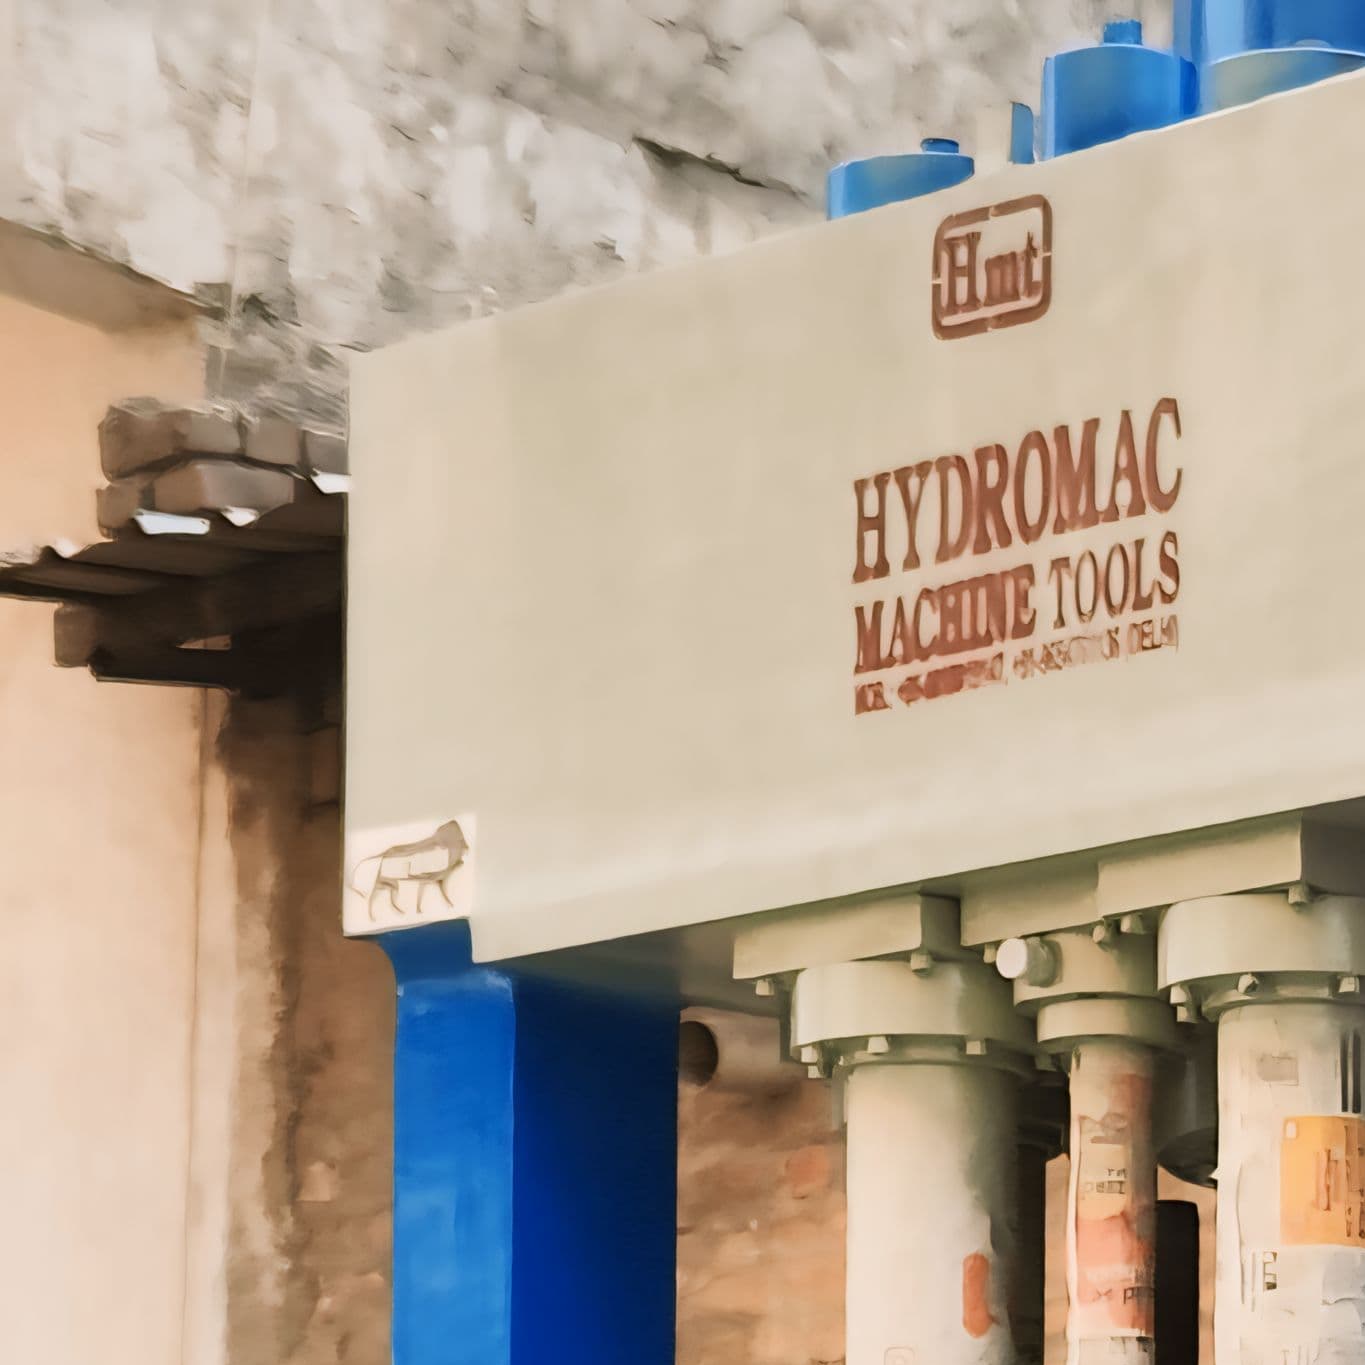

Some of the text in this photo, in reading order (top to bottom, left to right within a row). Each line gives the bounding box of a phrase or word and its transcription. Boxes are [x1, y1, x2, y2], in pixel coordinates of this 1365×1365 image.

[941, 230, 1039, 314] Hmt
[852, 397, 1182, 585] HYDROMAC
[853, 563, 1037, 676] MACHINE
[1048, 530, 1181, 631] TOOLS
